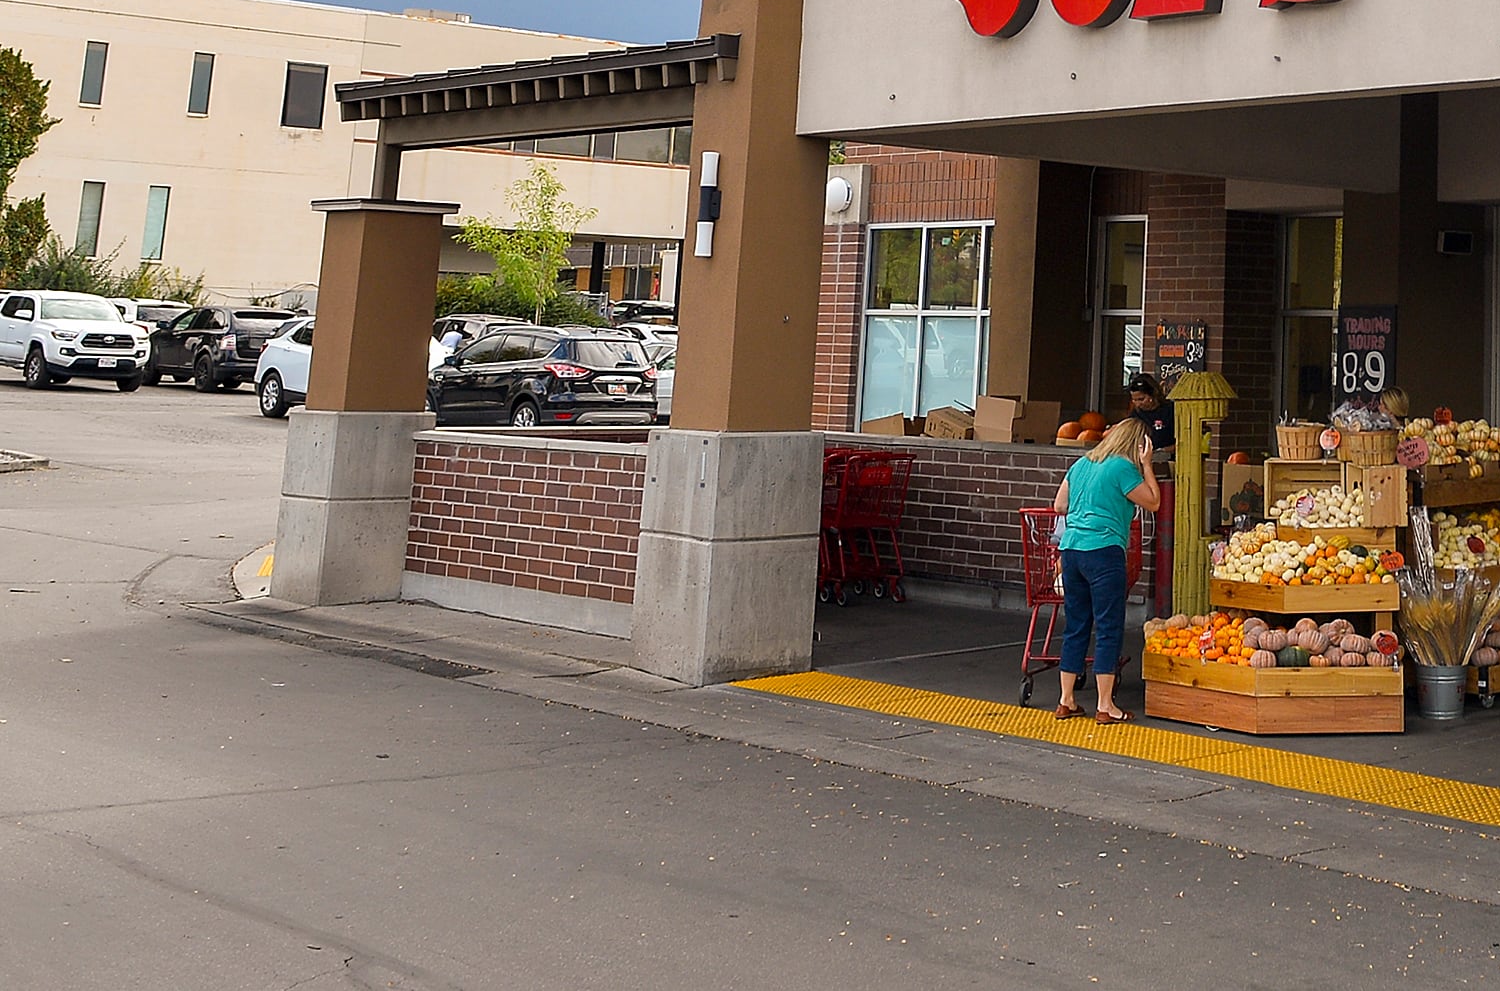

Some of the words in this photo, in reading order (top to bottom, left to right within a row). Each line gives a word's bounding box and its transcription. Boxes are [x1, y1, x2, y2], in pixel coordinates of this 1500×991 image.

[1344, 317, 1391, 334] TRADING
[1347, 335, 1385, 349] HOURS
[1342, 351, 1358, 394] 8
[1364, 351, 1385, 393] 9
